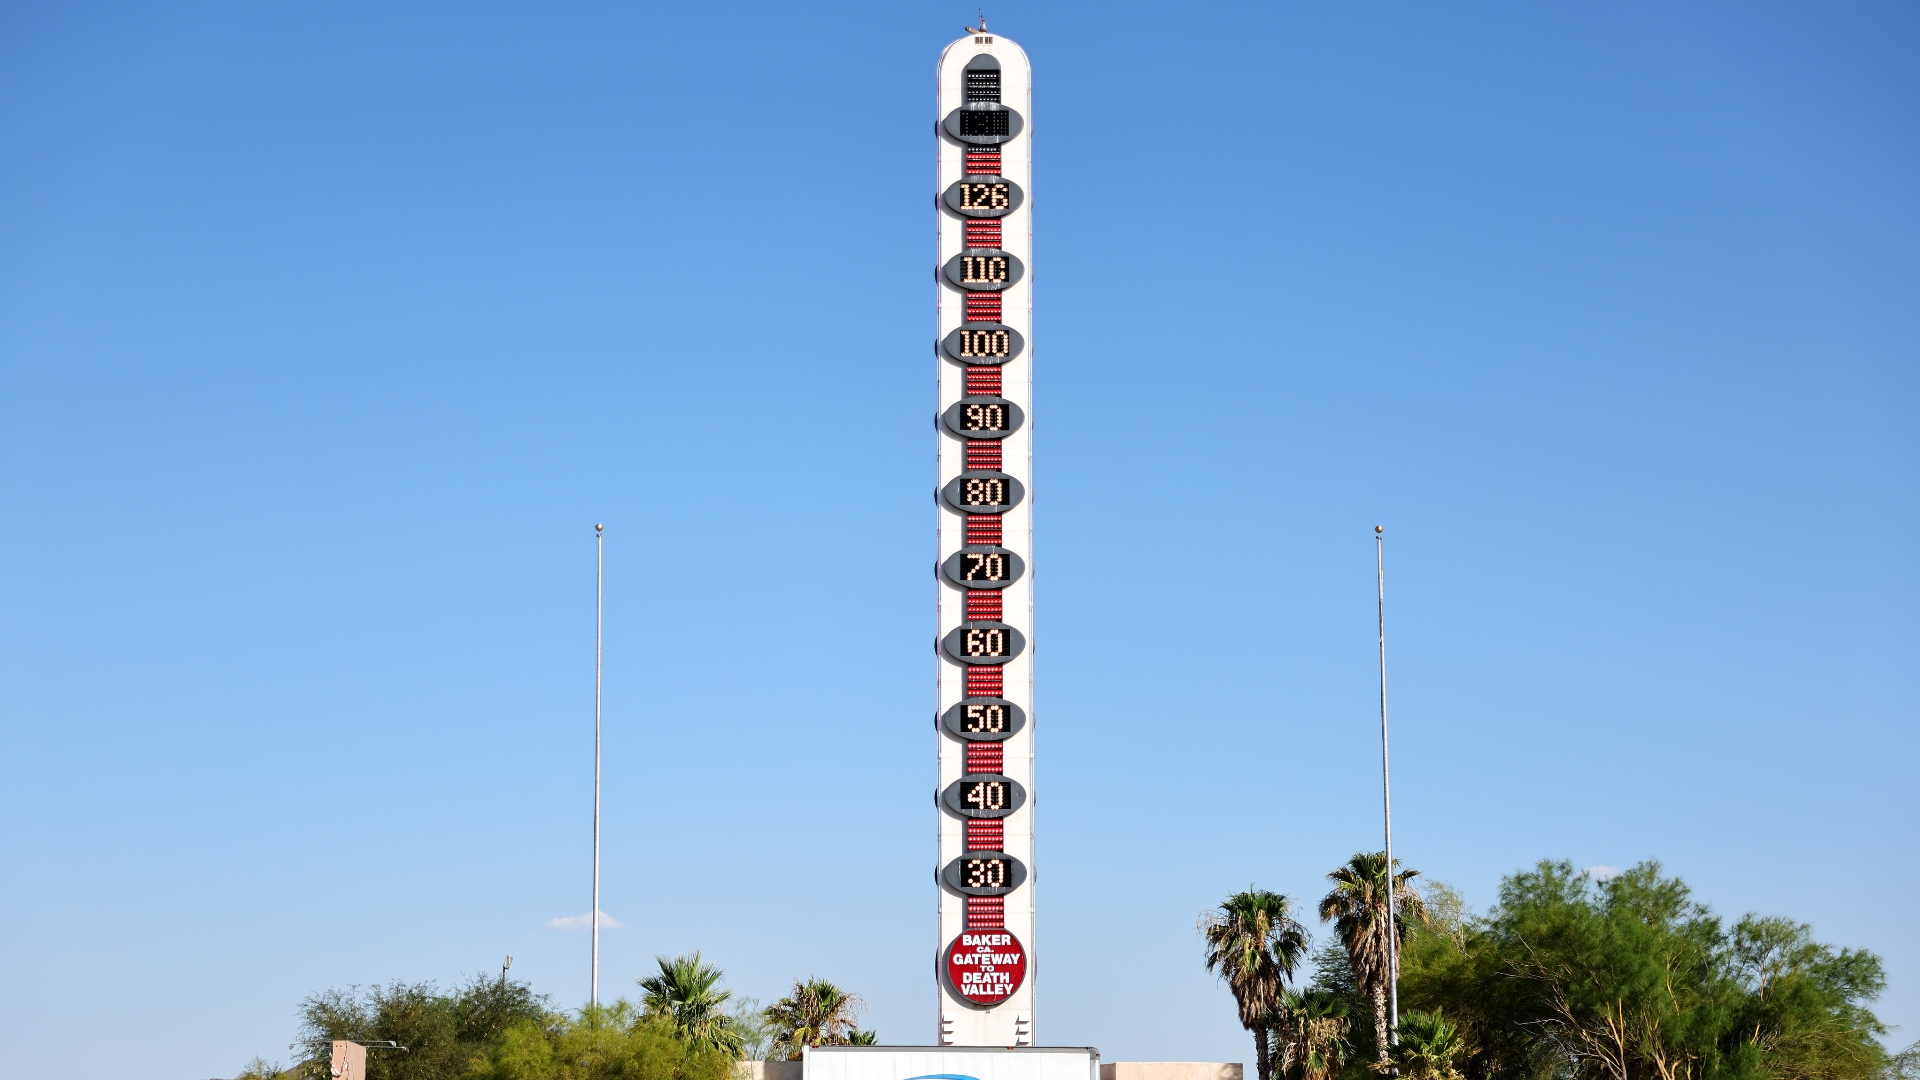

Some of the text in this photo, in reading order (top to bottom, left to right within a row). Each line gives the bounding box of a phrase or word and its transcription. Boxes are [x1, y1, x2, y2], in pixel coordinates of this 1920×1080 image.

[961, 184, 1008, 210] 126
[961, 330, 1008, 357] 100
[967, 404, 1002, 431] 90
[967, 478, 1002, 506] 80
[967, 553, 1002, 581] 70
[967, 628, 1003, 657] 60
[967, 705, 1003, 733] 50
[967, 782, 1003, 810] 40
[968, 859, 1003, 888] 30
[962, 934, 1011, 946] BAKER
[952, 953, 1020, 965] GATEWAY
[960, 984, 1013, 995] VALLEY
[962, 972, 1010, 983] DEATH
